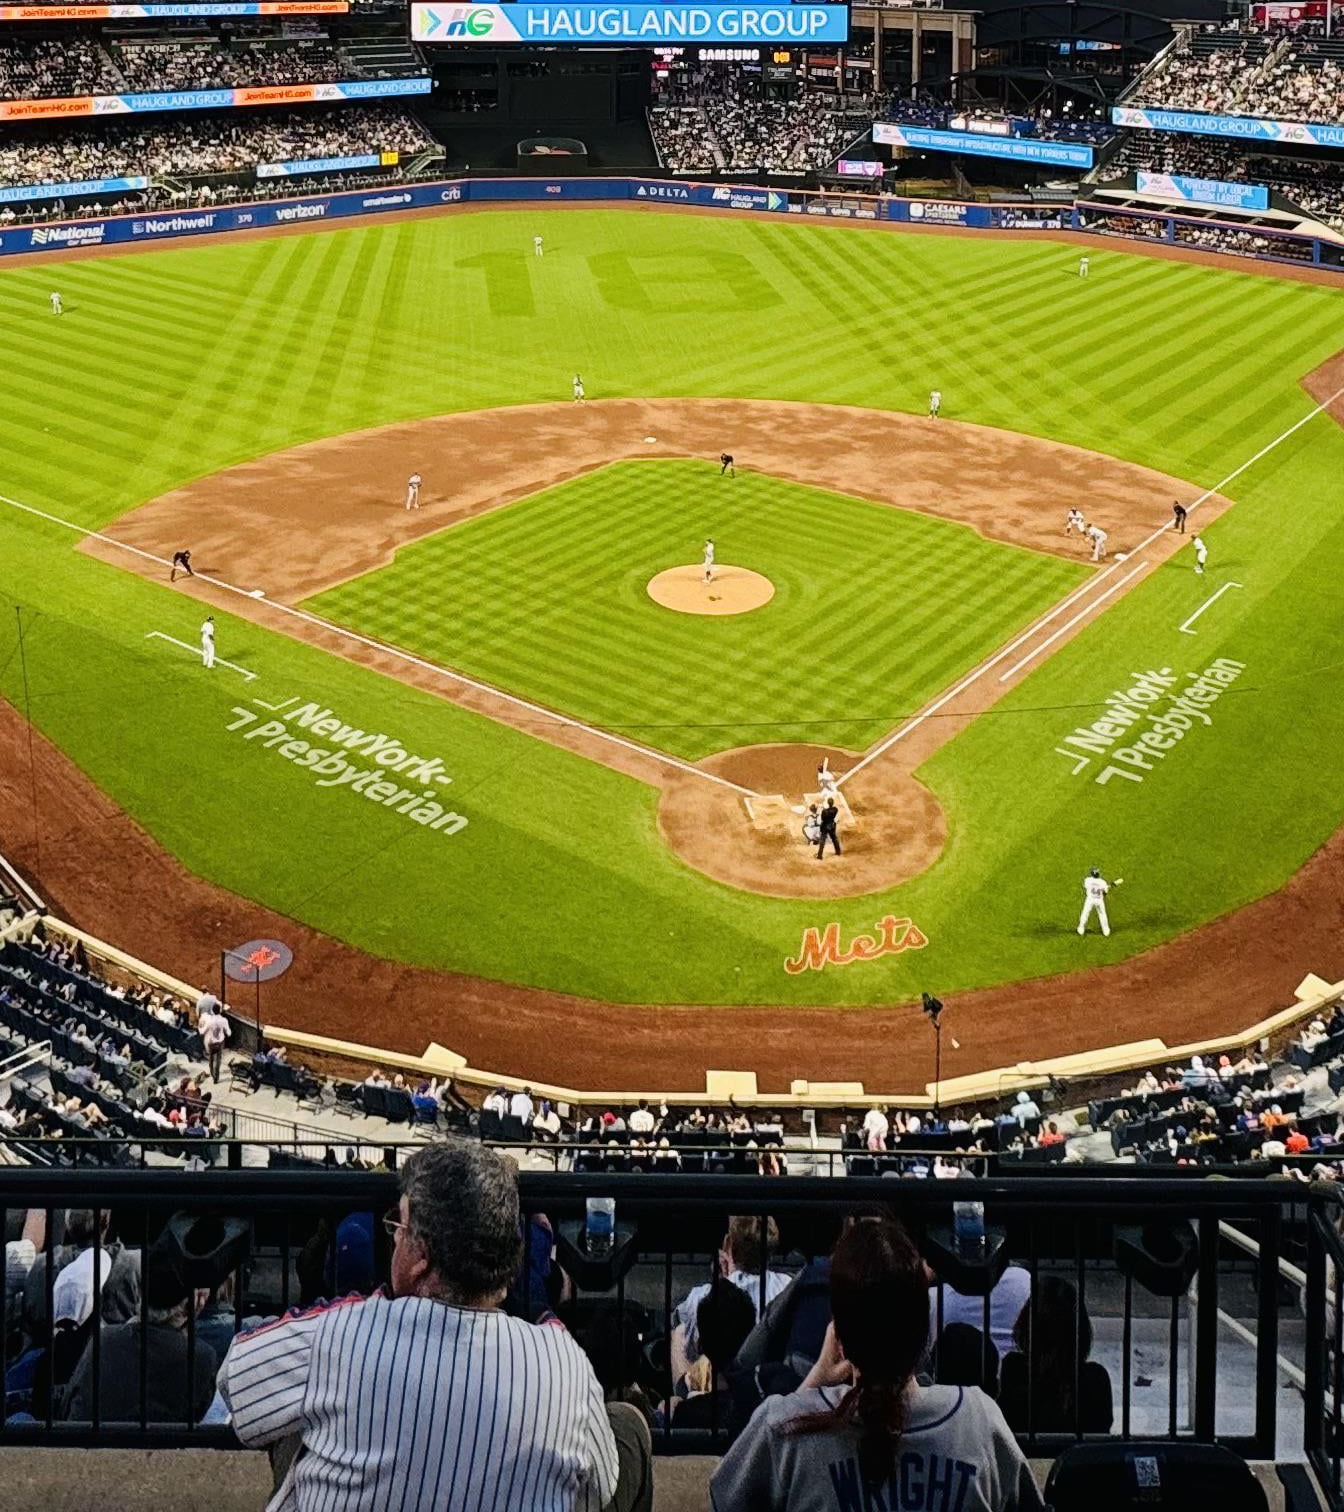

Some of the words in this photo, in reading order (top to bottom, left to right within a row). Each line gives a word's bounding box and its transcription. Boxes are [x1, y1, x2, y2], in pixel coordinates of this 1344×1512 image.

[528, 9, 711, 36] HAUGLAND
[717, 9, 828, 36] GROUP
[122, 45, 142, 54] THE
[144, 43, 180, 54] PORCH
[699, 49, 759, 61] SAMSUNG
[132, 94, 195, 108] HAUGLAND
[196, 91, 233, 104] GROUP
[7, 103, 89, 116] JoinTeamHG.com
[1153, 115, 1218, 132] HAUGLAND
[1219, 119, 1260, 135] GROUP
[61, 181, 104, 196] GROUP
[441, 186, 460, 201] citi
[649, 187, 689, 199] DELTA
[276, 203, 325, 220] verizon
[731, 201, 753, 209] GROUP
[924, 203, 966, 215] CAESARS
[48, 223, 105, 240] National
[145, 214, 214, 233] Northwell
[1065, 666, 1178, 754] NewYork-
[1118, 657, 1246, 771] Presbyterian
[283, 702, 453, 785] NewYork-
[244, 720, 469, 835] Presbyterian
[784, 915, 928, 975] Mets
[829, 1452, 976, 1512] WRIGHT
